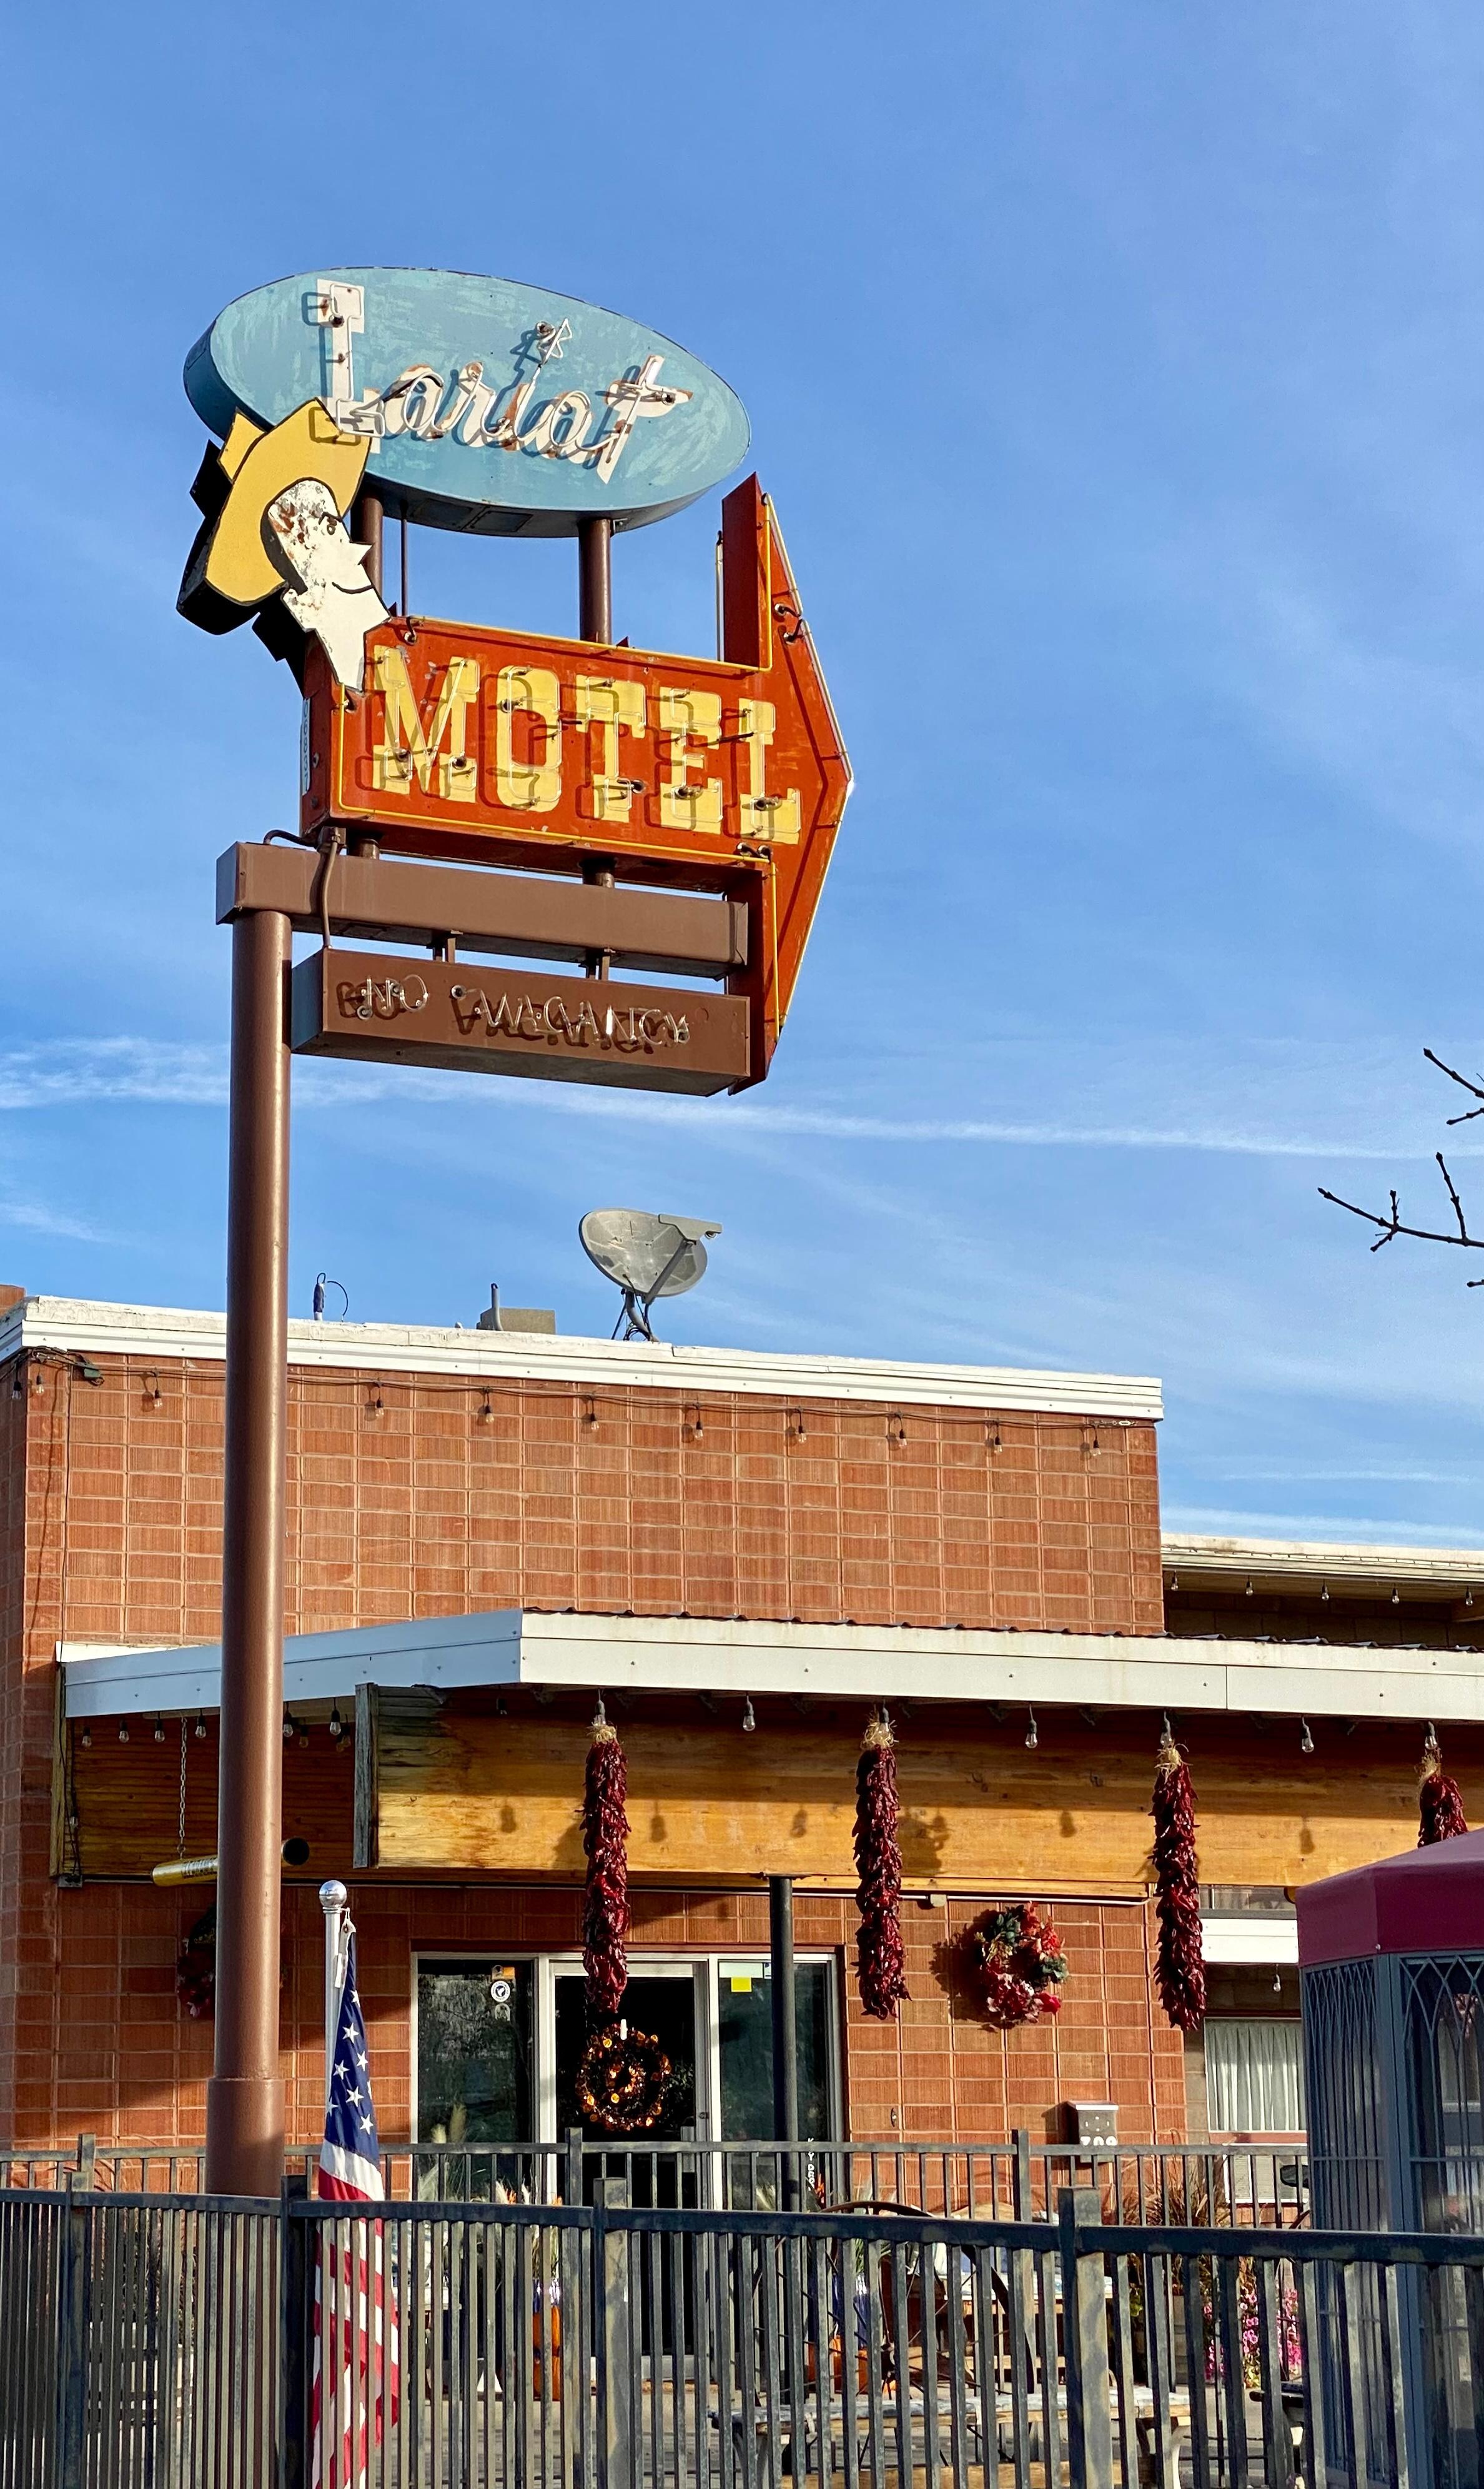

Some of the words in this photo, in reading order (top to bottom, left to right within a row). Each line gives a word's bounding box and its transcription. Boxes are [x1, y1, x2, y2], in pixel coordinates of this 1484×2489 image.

[316, 279, 693, 484] Lariat
[373, 644, 802, 844] MOTEL
[364, 973, 429, 1013] NO
[475, 988, 690, 1045] VACANCY
